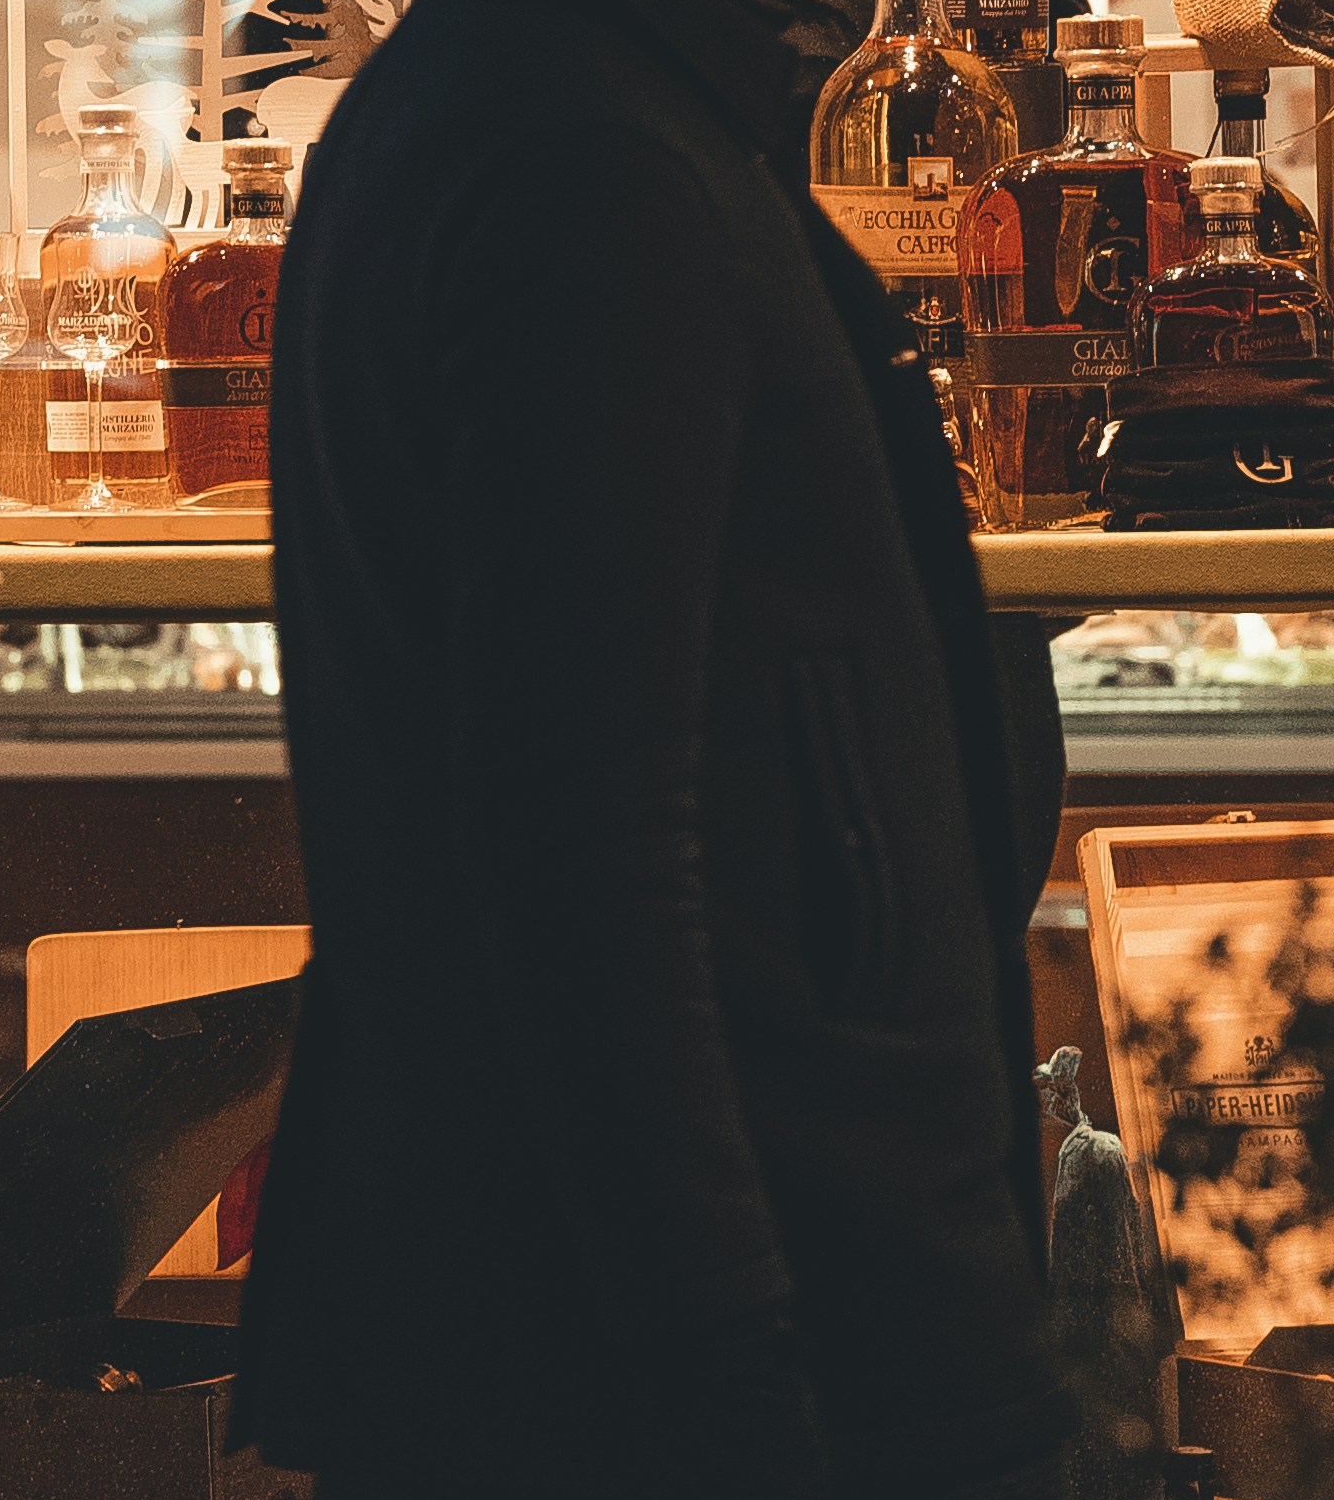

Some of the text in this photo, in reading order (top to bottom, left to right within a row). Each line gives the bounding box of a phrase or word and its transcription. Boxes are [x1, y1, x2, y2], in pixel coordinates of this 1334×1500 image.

[978, 0, 1030, 8] MARZADRO
[1076, 84, 1132, 101] GRAPPA
[237, 199, 283, 213] GRAPPA
[848, 206, 935, 230] VECCHIA
[1206, 219, 1251, 233] GRAPPA
[100, 414, 156, 424] DISTILLERIA
[101, 424, 154, 433] MARZADRO
